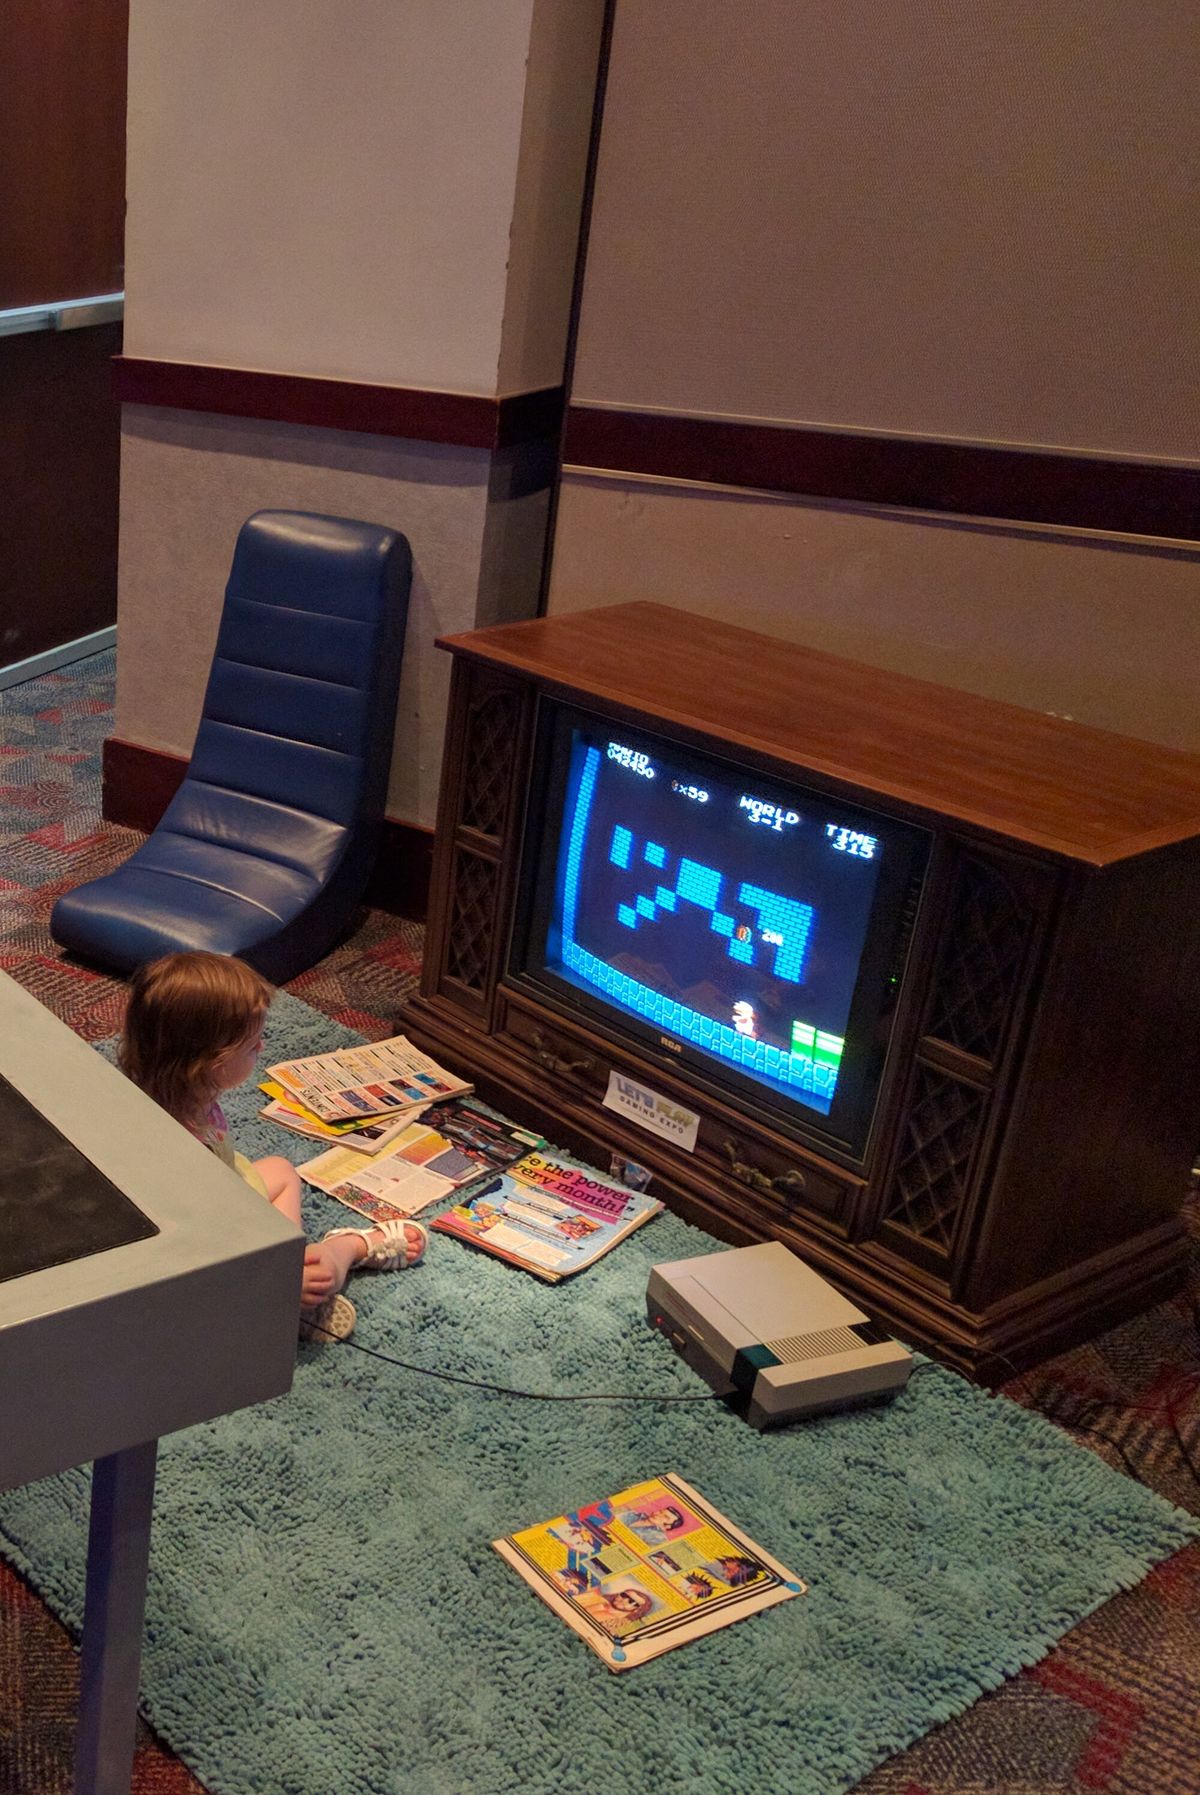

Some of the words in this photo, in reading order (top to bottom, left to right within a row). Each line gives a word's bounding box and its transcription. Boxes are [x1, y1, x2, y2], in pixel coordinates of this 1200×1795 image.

[739, 795, 800, 825] WORLD
[747, 809, 783, 832] 3-1
[826, 823, 879, 848] TIME
[660, 1036, 682, 1053] RCA
[619, 1095, 655, 1118] GAMING
[660, 1117, 684, 1134] EXPO
[543, 1161, 574, 1180] the
[571, 1174, 636, 1204] power
